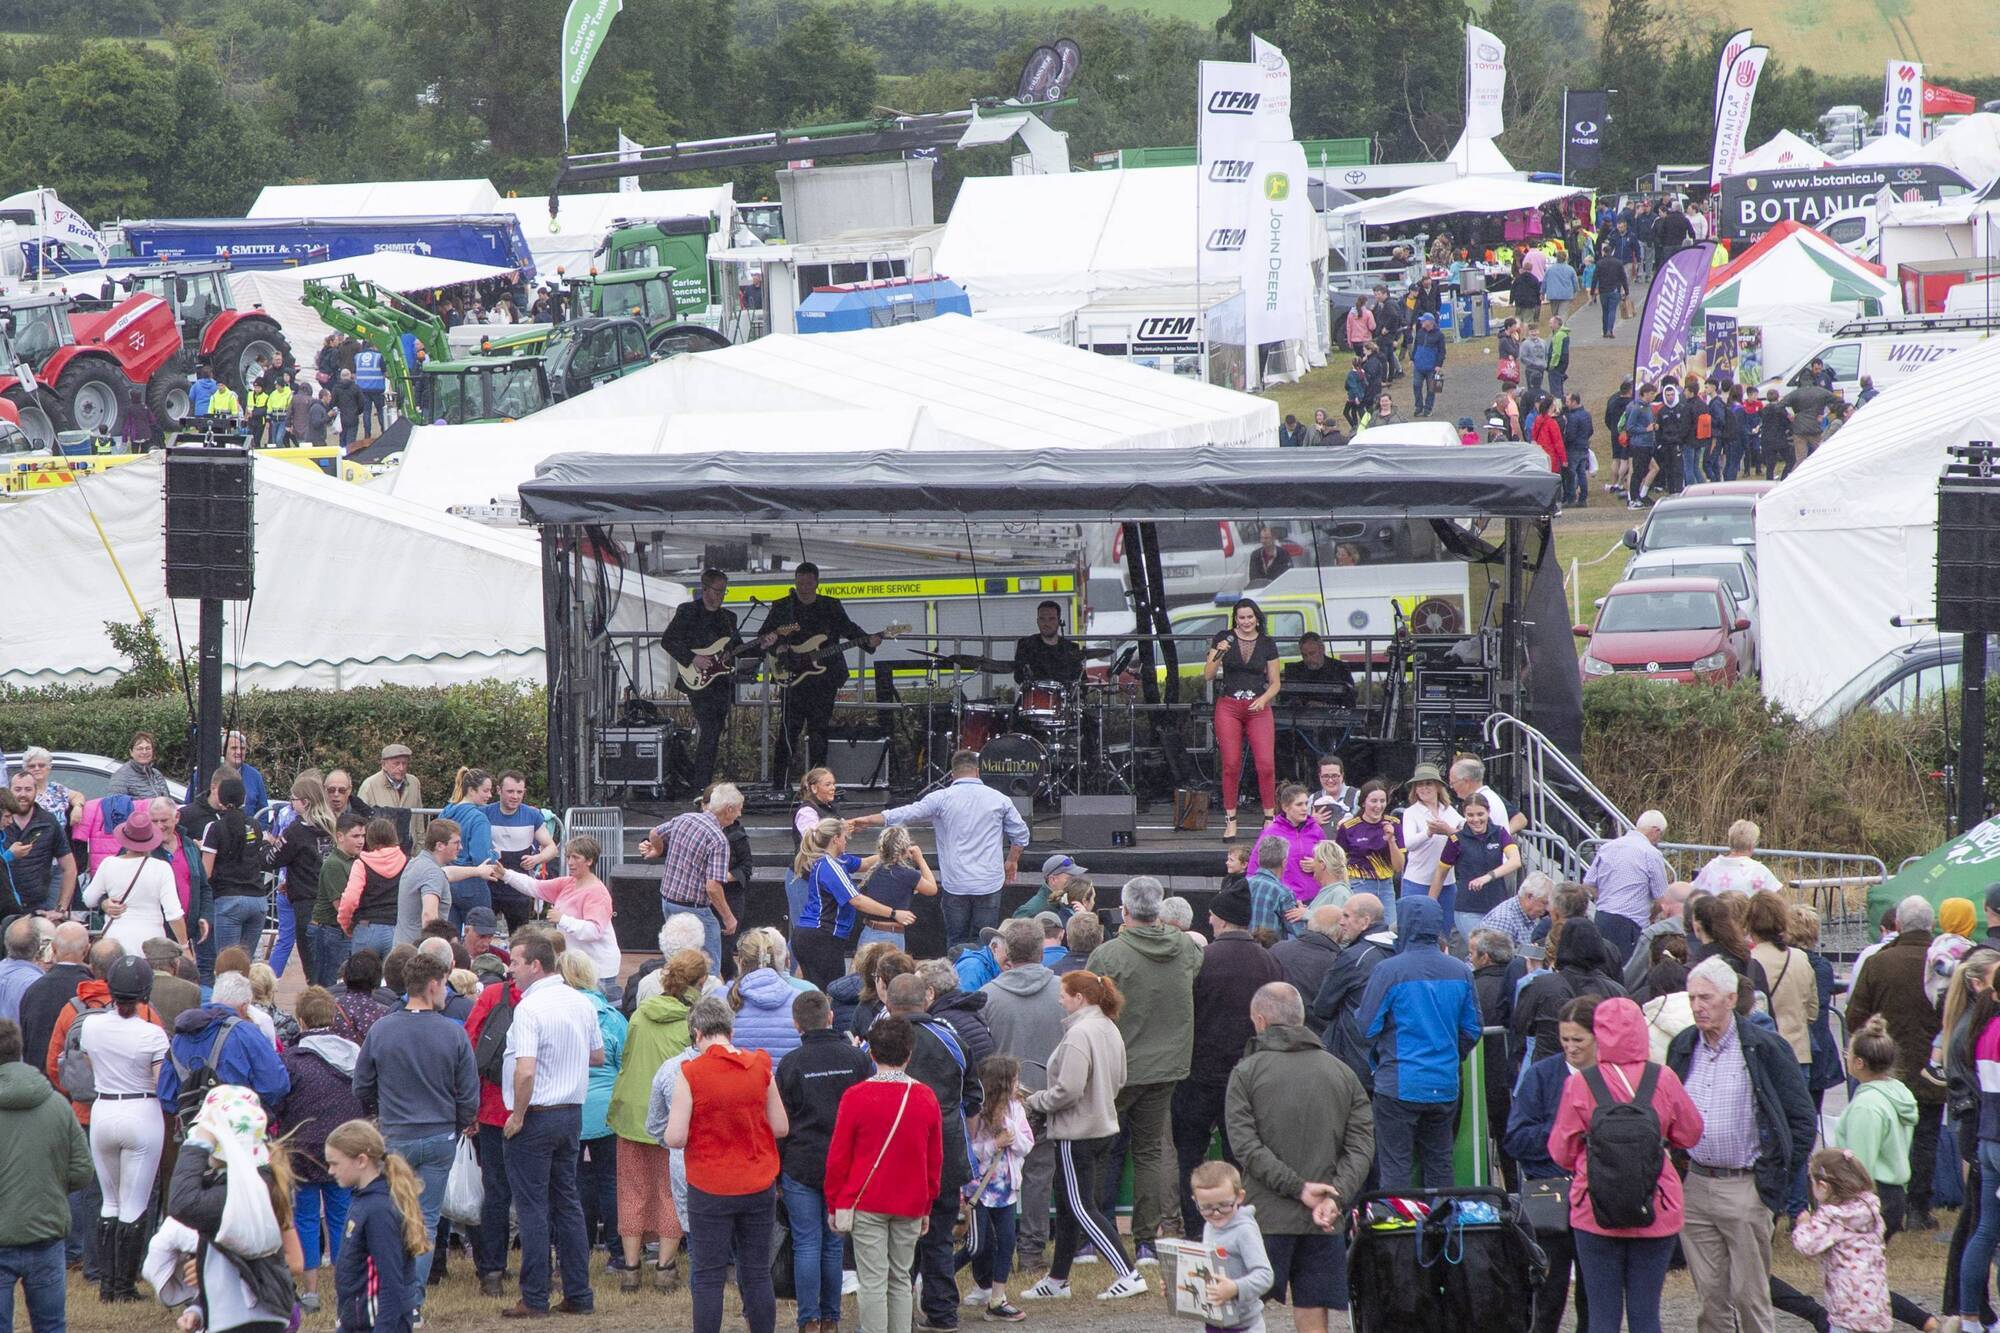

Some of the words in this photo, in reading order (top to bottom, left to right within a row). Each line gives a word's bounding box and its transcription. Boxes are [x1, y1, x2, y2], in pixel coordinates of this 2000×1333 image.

[570, 13, 591, 55] Carlow
[571, 30, 596, 84] Concrete
[591, 0, 609, 26] Tank
[1217, 90, 1261, 110] TFM
[1895, 86, 1913, 139] SUZ
[1217, 160, 1254, 178] TFM
[1772, 172, 1886, 189] www.botanica.ie
[1740, 193, 1877, 225] BOTANIC
[1216, 229, 1247, 246] TFM
[1270, 208, 1284, 254] JOHN
[215, 245, 228, 255] M
[231, 244, 275, 255] SMITH
[278, 245, 290, 254] &
[373, 243, 416, 252] SCHMITZ
[672, 279, 702, 287] Carlow
[1266, 257, 1282, 311] DEERE
[676, 296, 702, 304] Tanks
[1148, 318, 1195, 335] TFM
[1888, 345, 1957, 361] Whiz
[825, 585, 865, 595] WICKLOW
[866, 585, 885, 594] FIRE
[886, 584, 921, 593] SERVICE
[981, 758, 1041, 773] Matrimony
